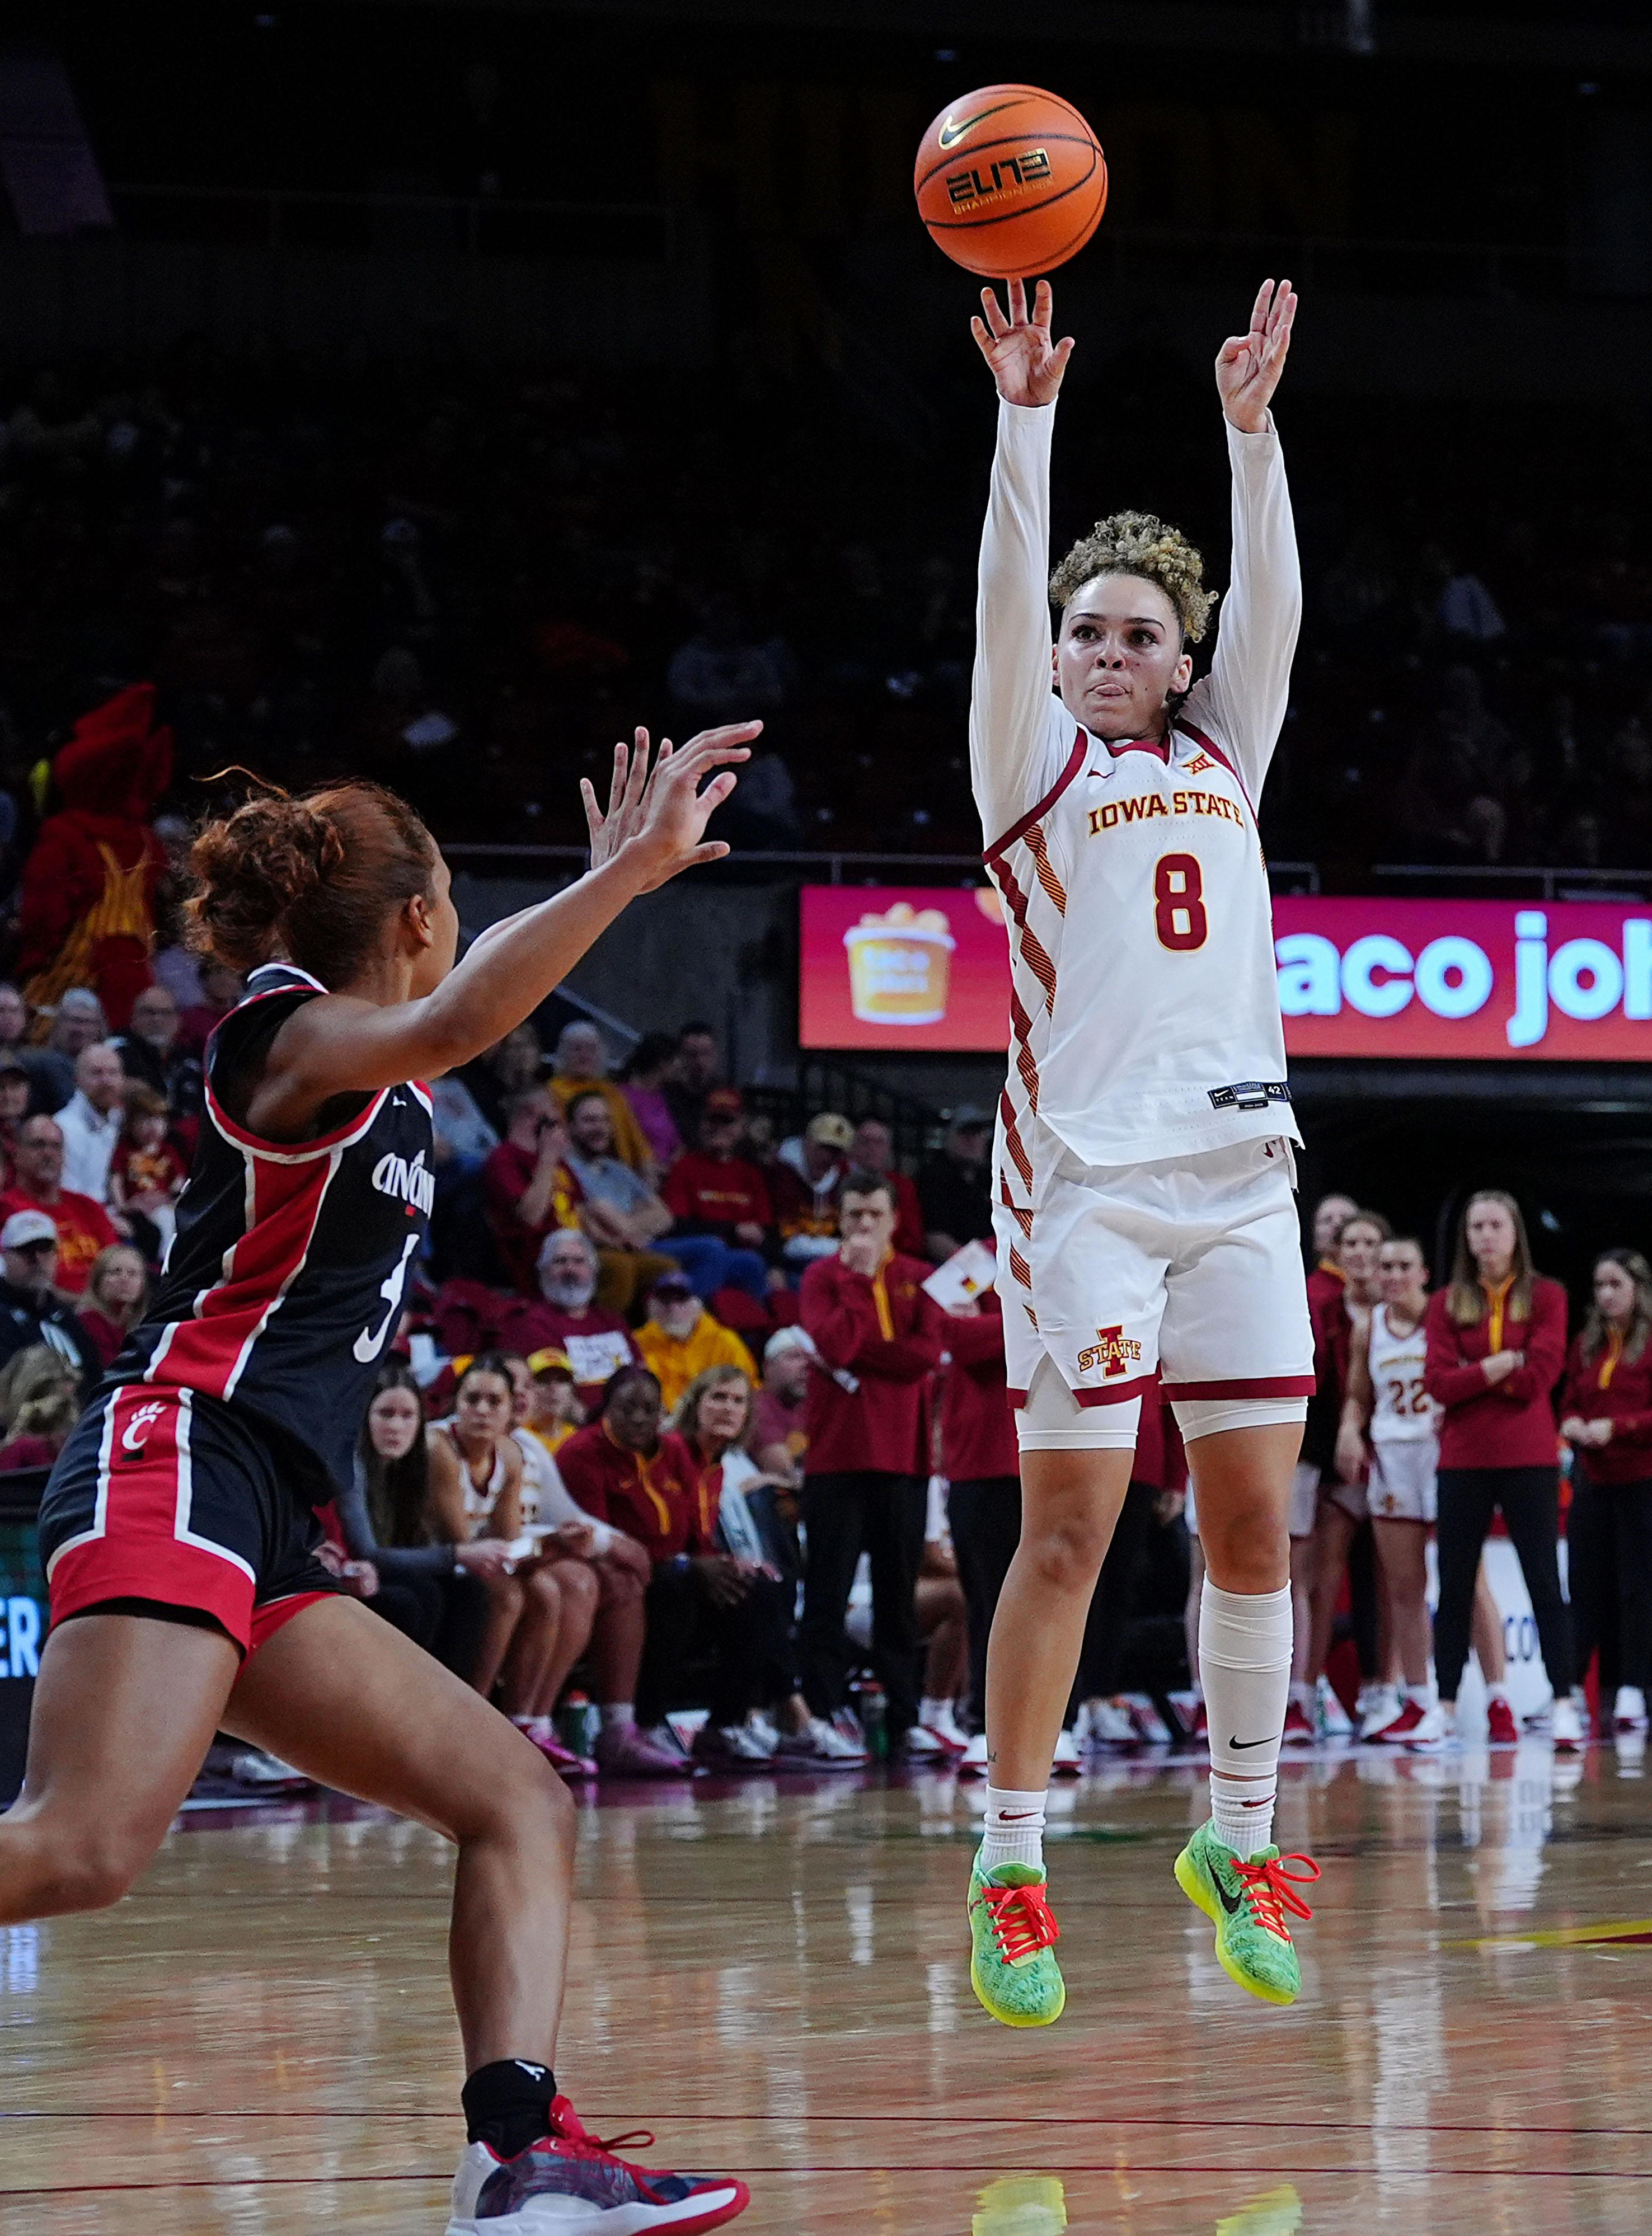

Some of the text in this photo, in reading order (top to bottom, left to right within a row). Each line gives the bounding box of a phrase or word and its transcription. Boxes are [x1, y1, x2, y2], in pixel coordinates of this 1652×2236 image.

[946, 152, 1050, 202] ELITE
[1088, 791, 1245, 838] IOWA STATE
[1154, 853, 1209, 952] 8
[1268, 1086, 1282, 1094] 42
[1078, 1339, 1142, 1373] STATE
[1389, 1379, 1428, 1416] 22
